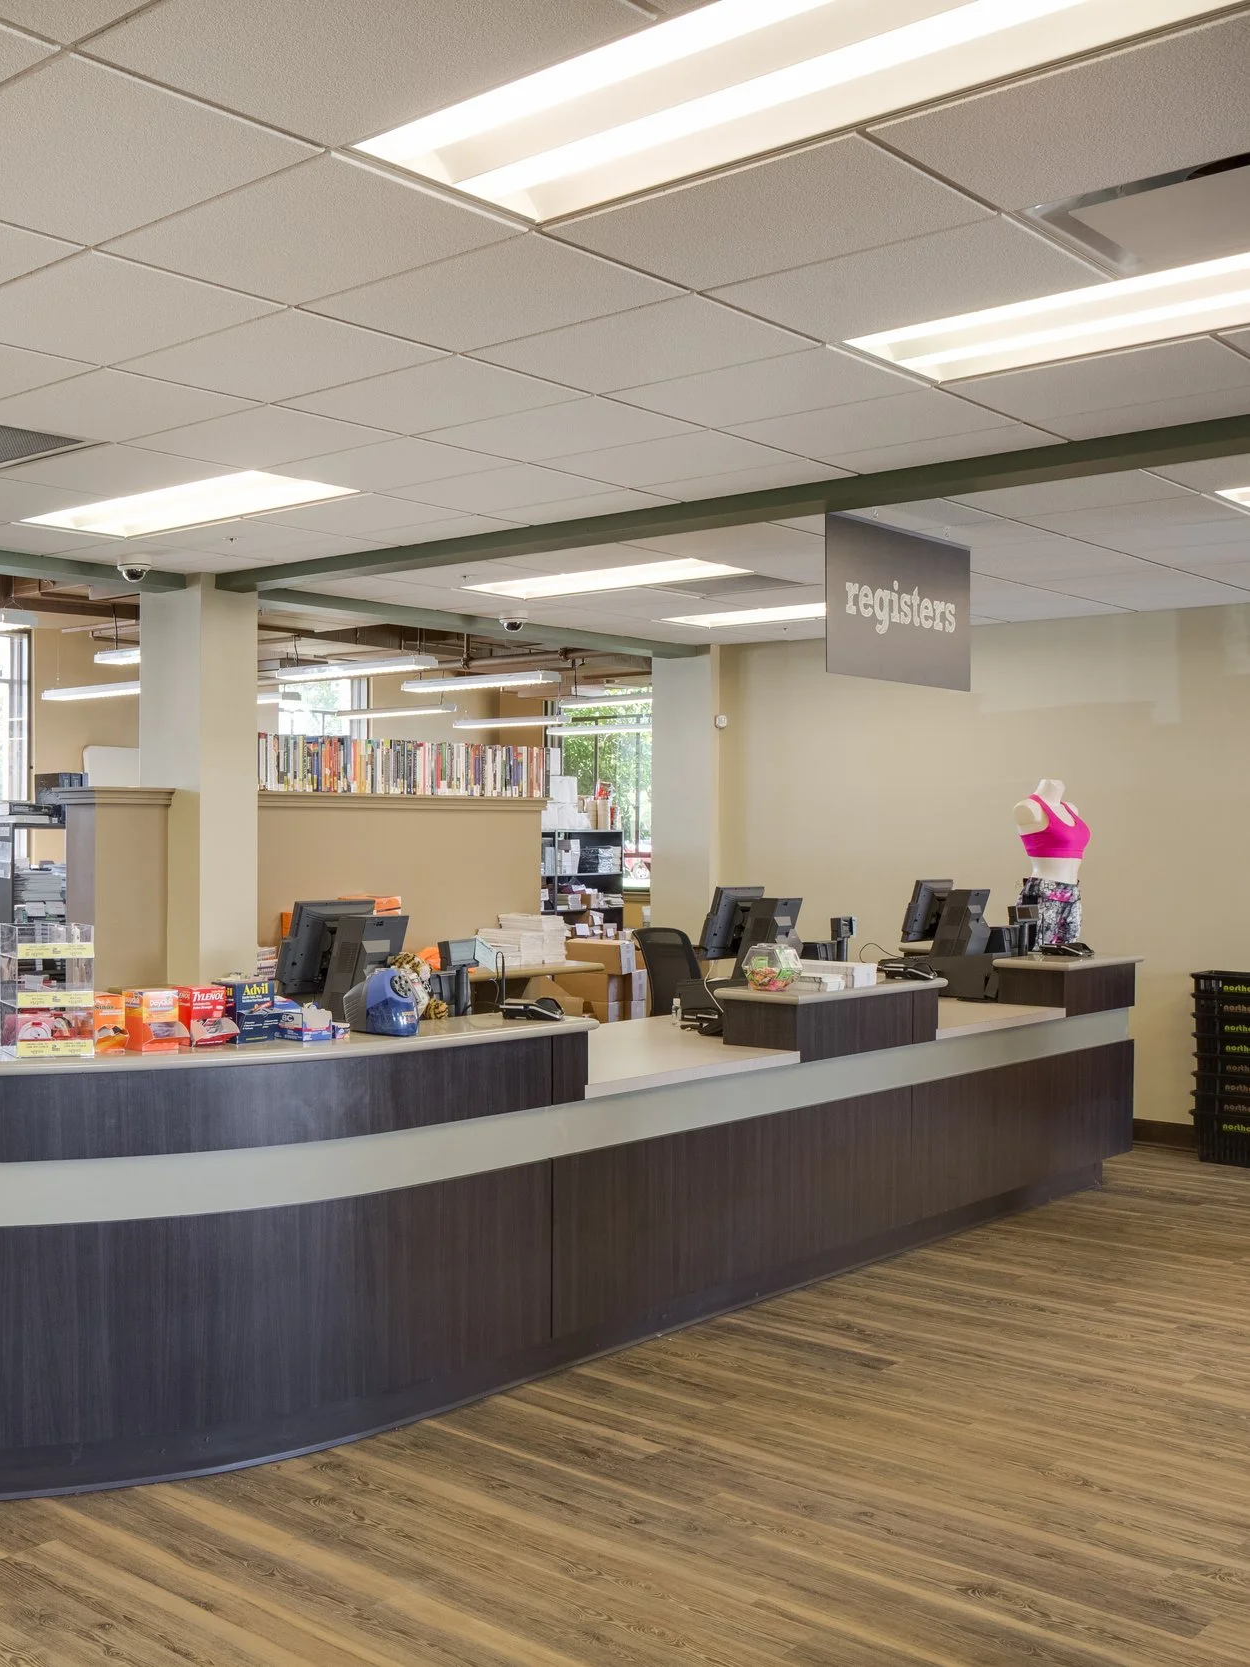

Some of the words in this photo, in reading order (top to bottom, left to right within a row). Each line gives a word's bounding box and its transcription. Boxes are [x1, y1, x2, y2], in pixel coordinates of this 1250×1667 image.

[845, 580, 956, 635] registers
[243, 982, 269, 995] Advil
[193, 991, 225, 1002] TYLENOL
